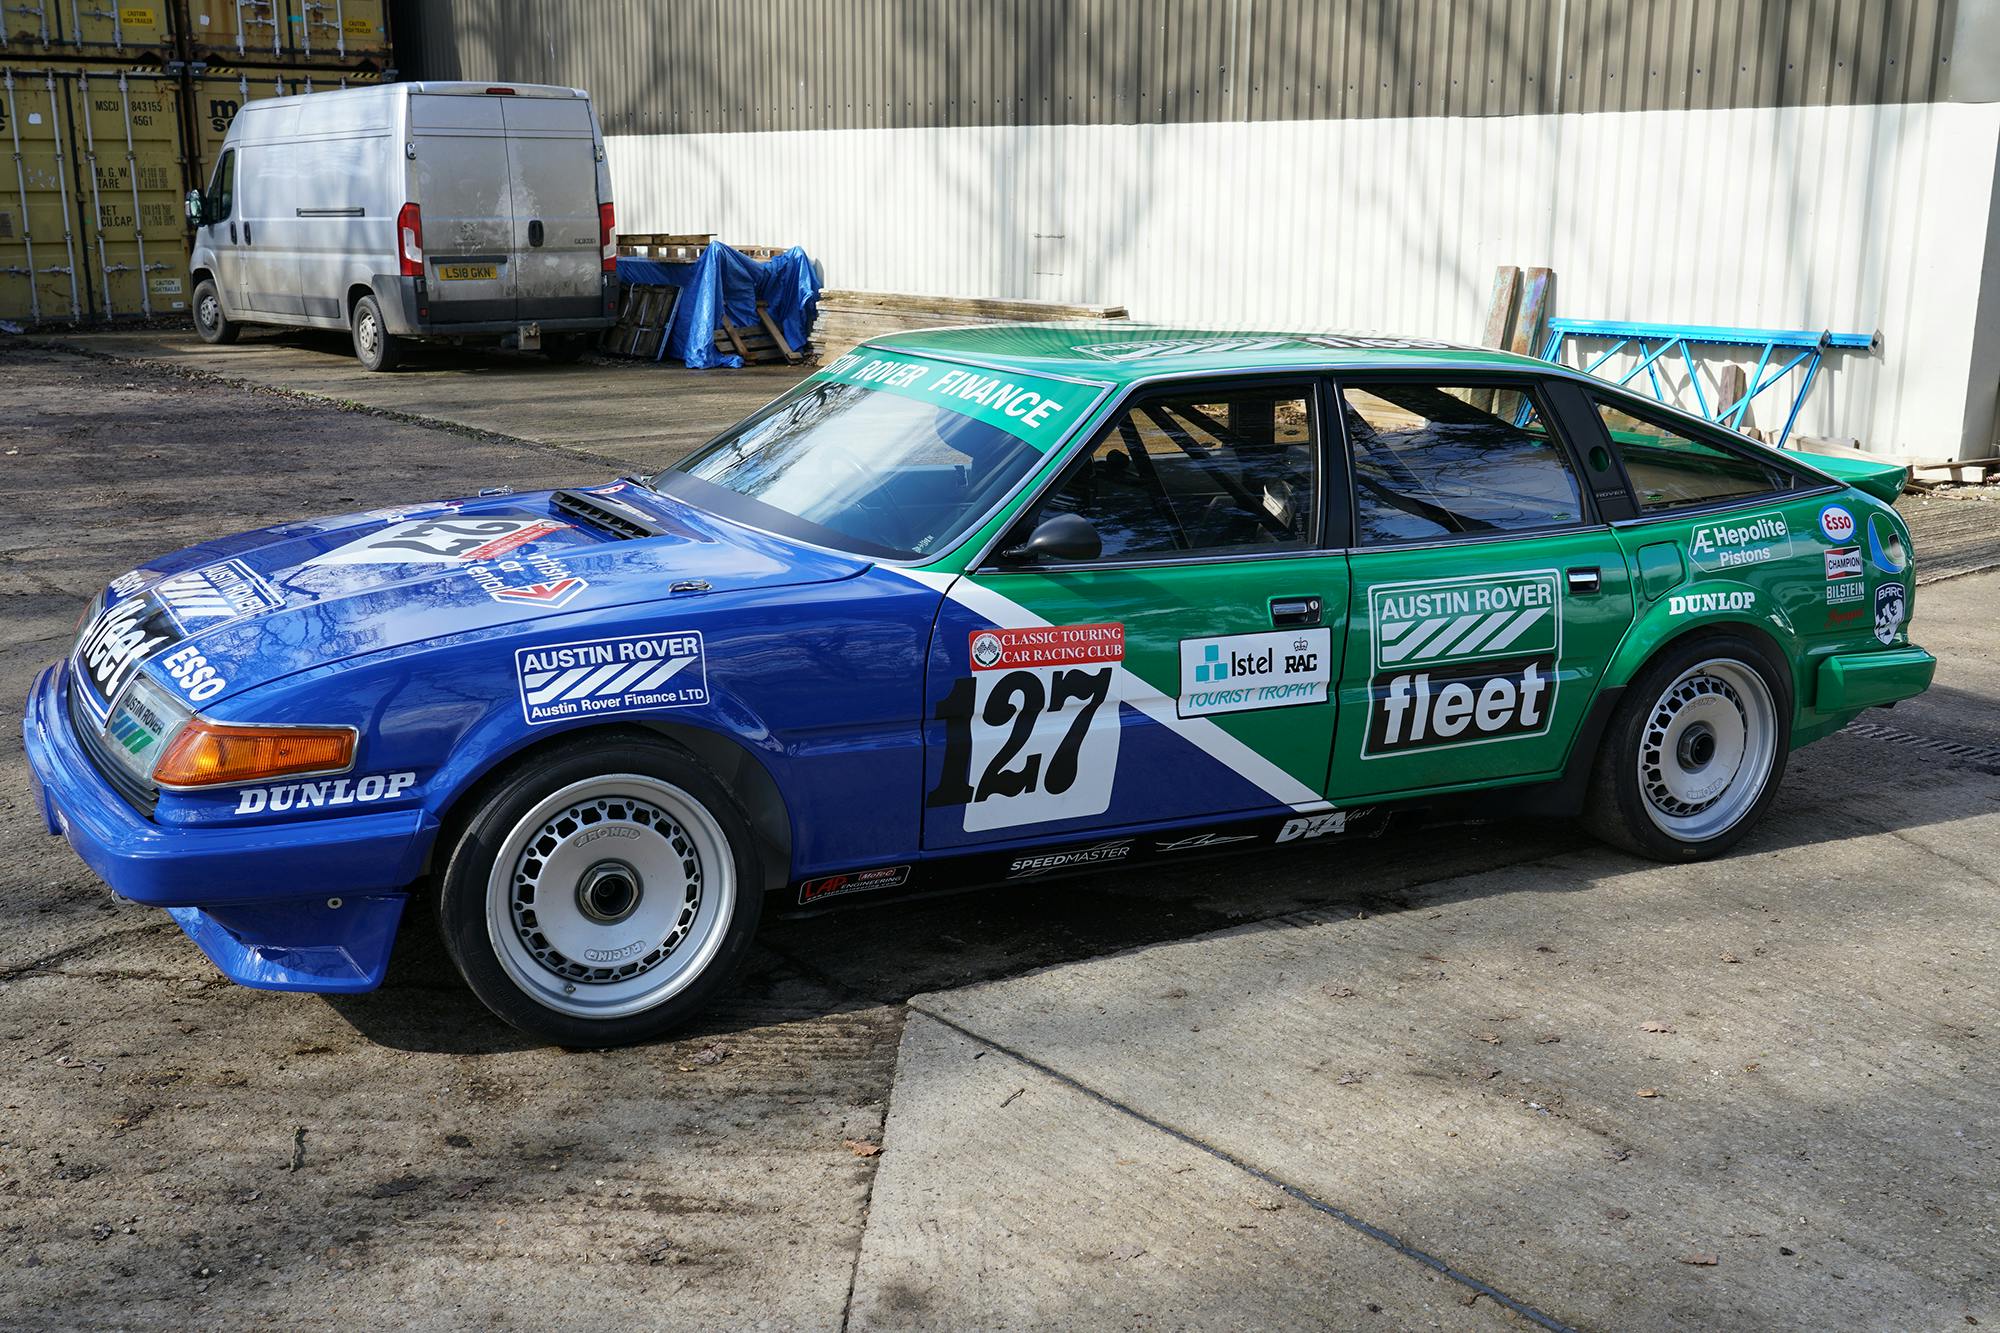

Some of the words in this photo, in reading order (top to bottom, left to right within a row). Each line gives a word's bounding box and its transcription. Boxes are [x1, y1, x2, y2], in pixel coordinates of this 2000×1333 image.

[95, 100, 119, 112] MSCU
[98, 178, 121, 189] TARE
[99, 204, 117, 216] NET
[446, 268, 469, 279] LS18
[470, 266, 492, 278] GKN
[850, 359, 930, 388] ROVER
[928, 370, 1064, 429] FINANCE
[1713, 518, 1787, 547] Hepolite
[528, 553, 573, 581] ritish
[1719, 547, 1771, 567] Pistons
[1828, 556, 1861, 570] CHAMPION
[110, 570, 146, 598] ESSO
[203, 566, 232, 589] AUSTIN
[222, 582, 267, 615] ROVER
[1826, 581, 1865, 599] BILSTEIN
[1878, 586, 1903, 600] BARC
[1381, 590, 1470, 621] AUSTIN
[1475, 583, 1553, 611] ROVER
[1668, 591, 1756, 616] DUNLOP
[83, 598, 169, 697] fleet
[1001, 631, 1061, 647] CLASSIC
[1063, 628, 1122, 643] TOURING
[523, 644, 614, 673] AUSTIN
[618, 636, 699, 660] ROVER
[1001, 650, 1031, 664] CAR
[1033, 647, 1085, 661] RACING
[1087, 644, 1123, 658] CLUB
[1231, 647, 1273, 677] Istel
[1284, 653, 1318, 674] RAC
[162, 645, 226, 702] ESSO
[531, 702, 578, 719] Austin
[581, 697, 621, 712] Rover
[624, 690, 677, 706] Finance
[678, 688, 705, 701] LTD
[1188, 687, 1255, 708] TOURIST
[1257, 681, 1320, 701] TROPHY
[1383, 661, 1545, 745] fleet
[123, 694, 145, 720] AUSTIN
[142, 708, 164, 736] ROVER
[926, 667, 1113, 808] 127
[234, 772, 416, 815] DUNLOP
[1275, 811, 1347, 844] DTA
[1010, 846, 1130, 871] SPEEDMASTER
[840, 876, 902, 889] ENGINEERING
[588, 942, 642, 961] RACING
